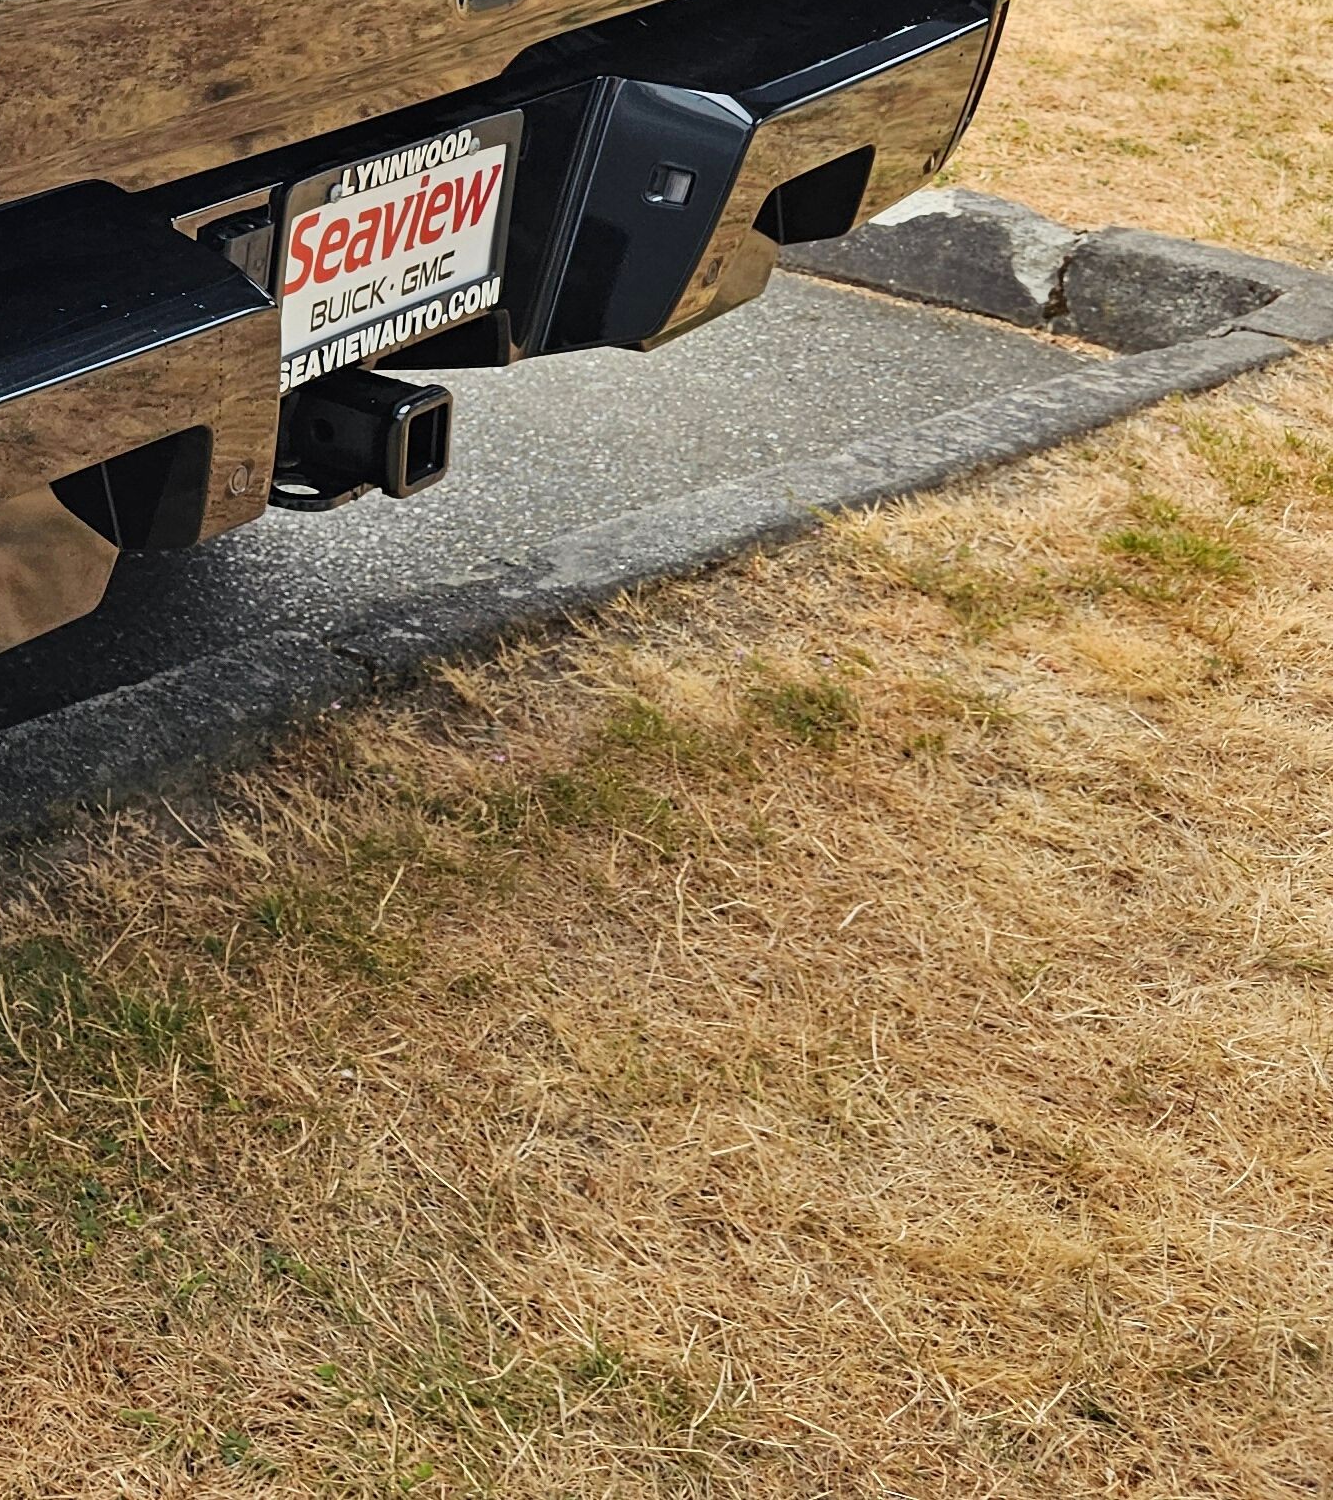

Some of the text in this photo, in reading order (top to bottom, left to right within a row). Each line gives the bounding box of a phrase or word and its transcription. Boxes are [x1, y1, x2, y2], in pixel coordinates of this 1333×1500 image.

[341, 129, 472, 197] LYNNWOOD
[282, 163, 502, 297] Seaview
[279, 276, 501, 393] SEAVIEWAUTO.COM
[309, 250, 456, 333] BUICK GMC
